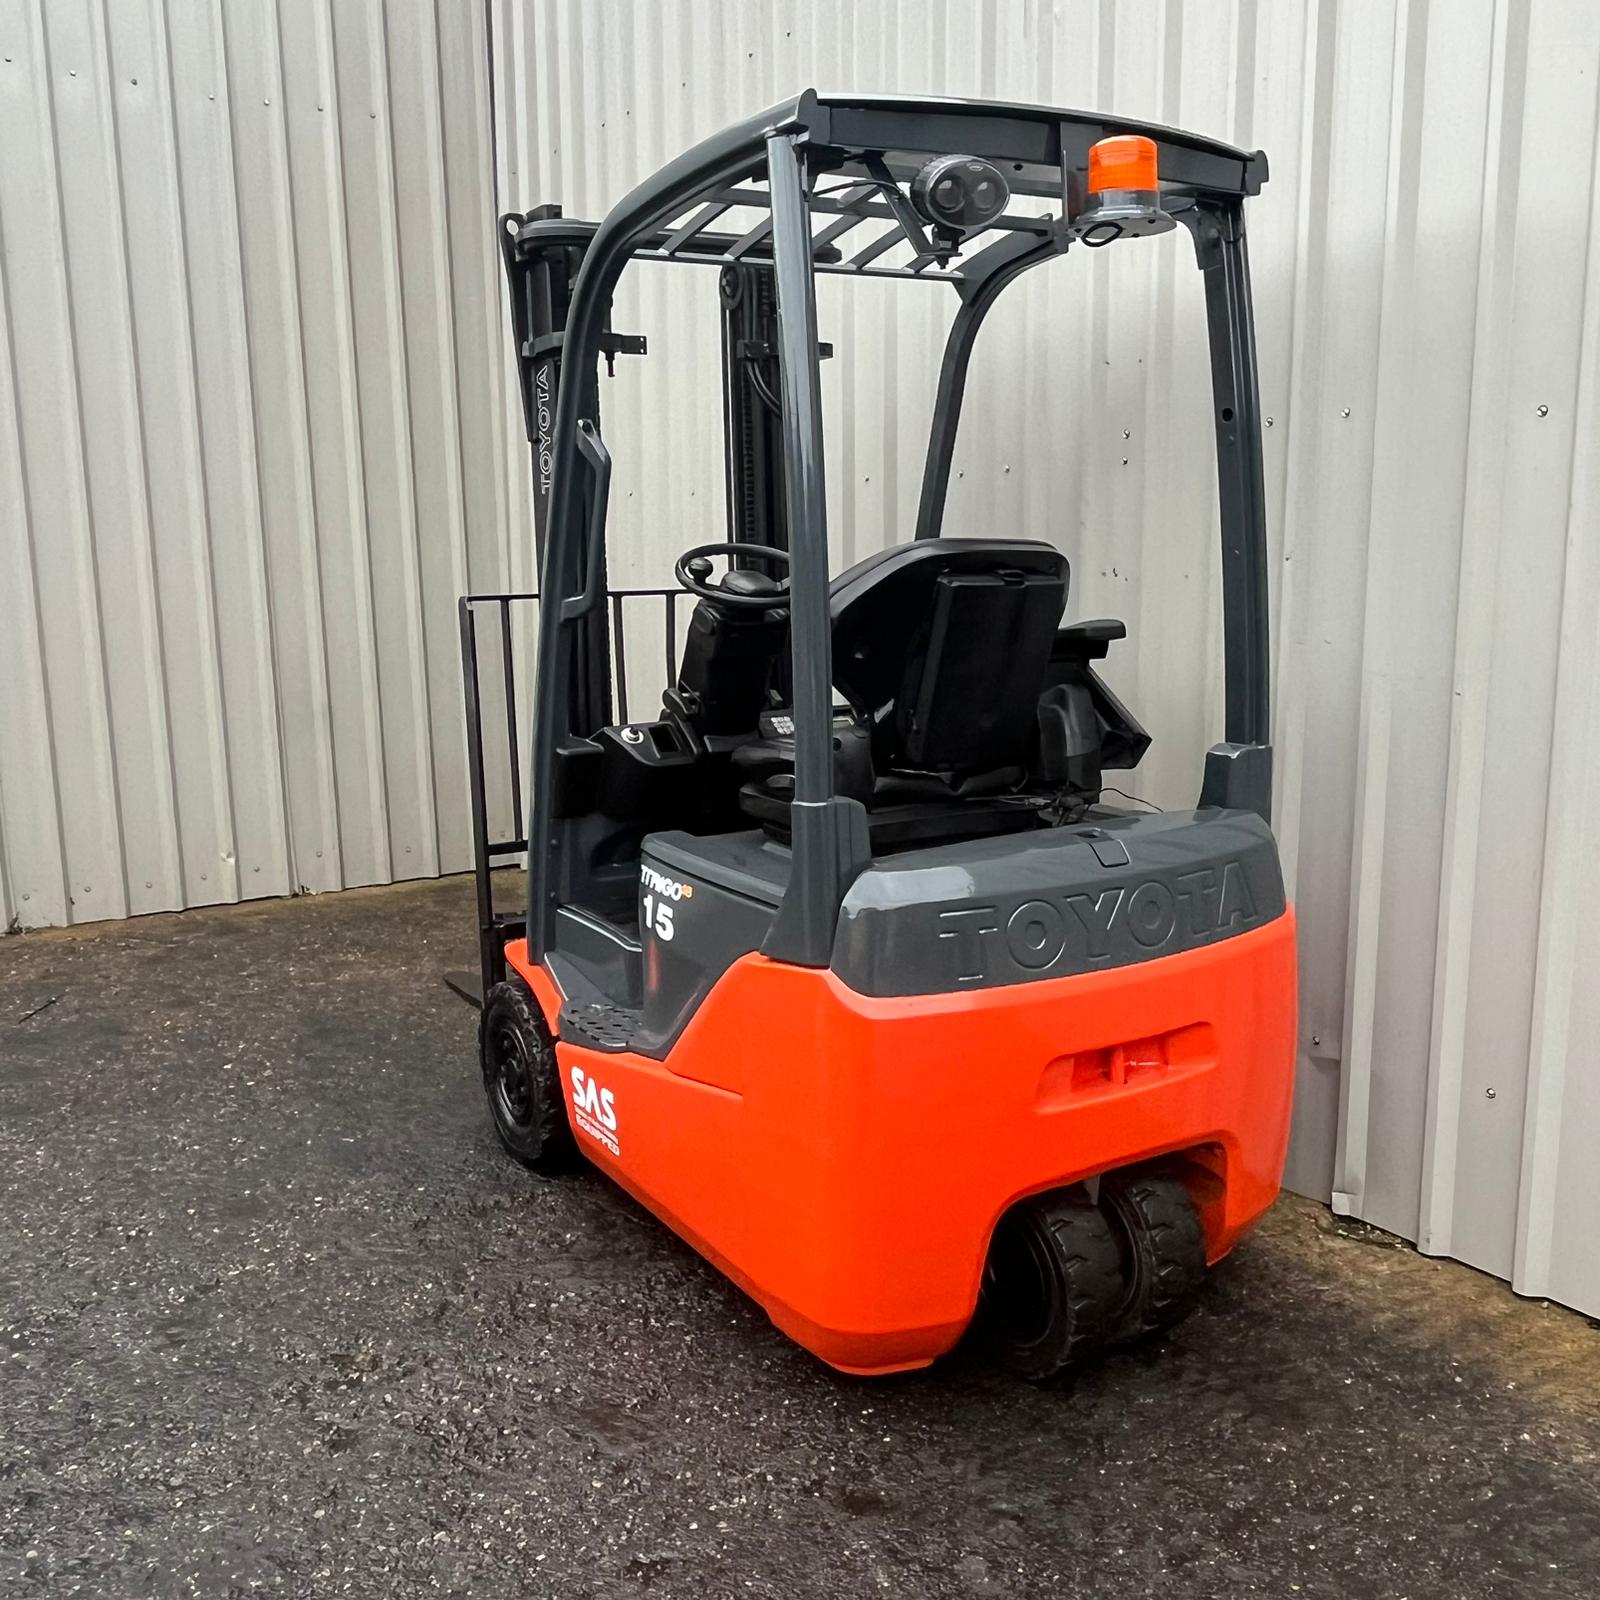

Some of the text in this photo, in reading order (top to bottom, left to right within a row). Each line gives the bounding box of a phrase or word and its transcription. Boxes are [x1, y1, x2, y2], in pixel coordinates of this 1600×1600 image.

[536, 365, 552, 495] TOYOTA
[643, 894, 675, 942] 15
[939, 862, 1258, 981] TOYOTA
[571, 1066, 617, 1131] SAS
